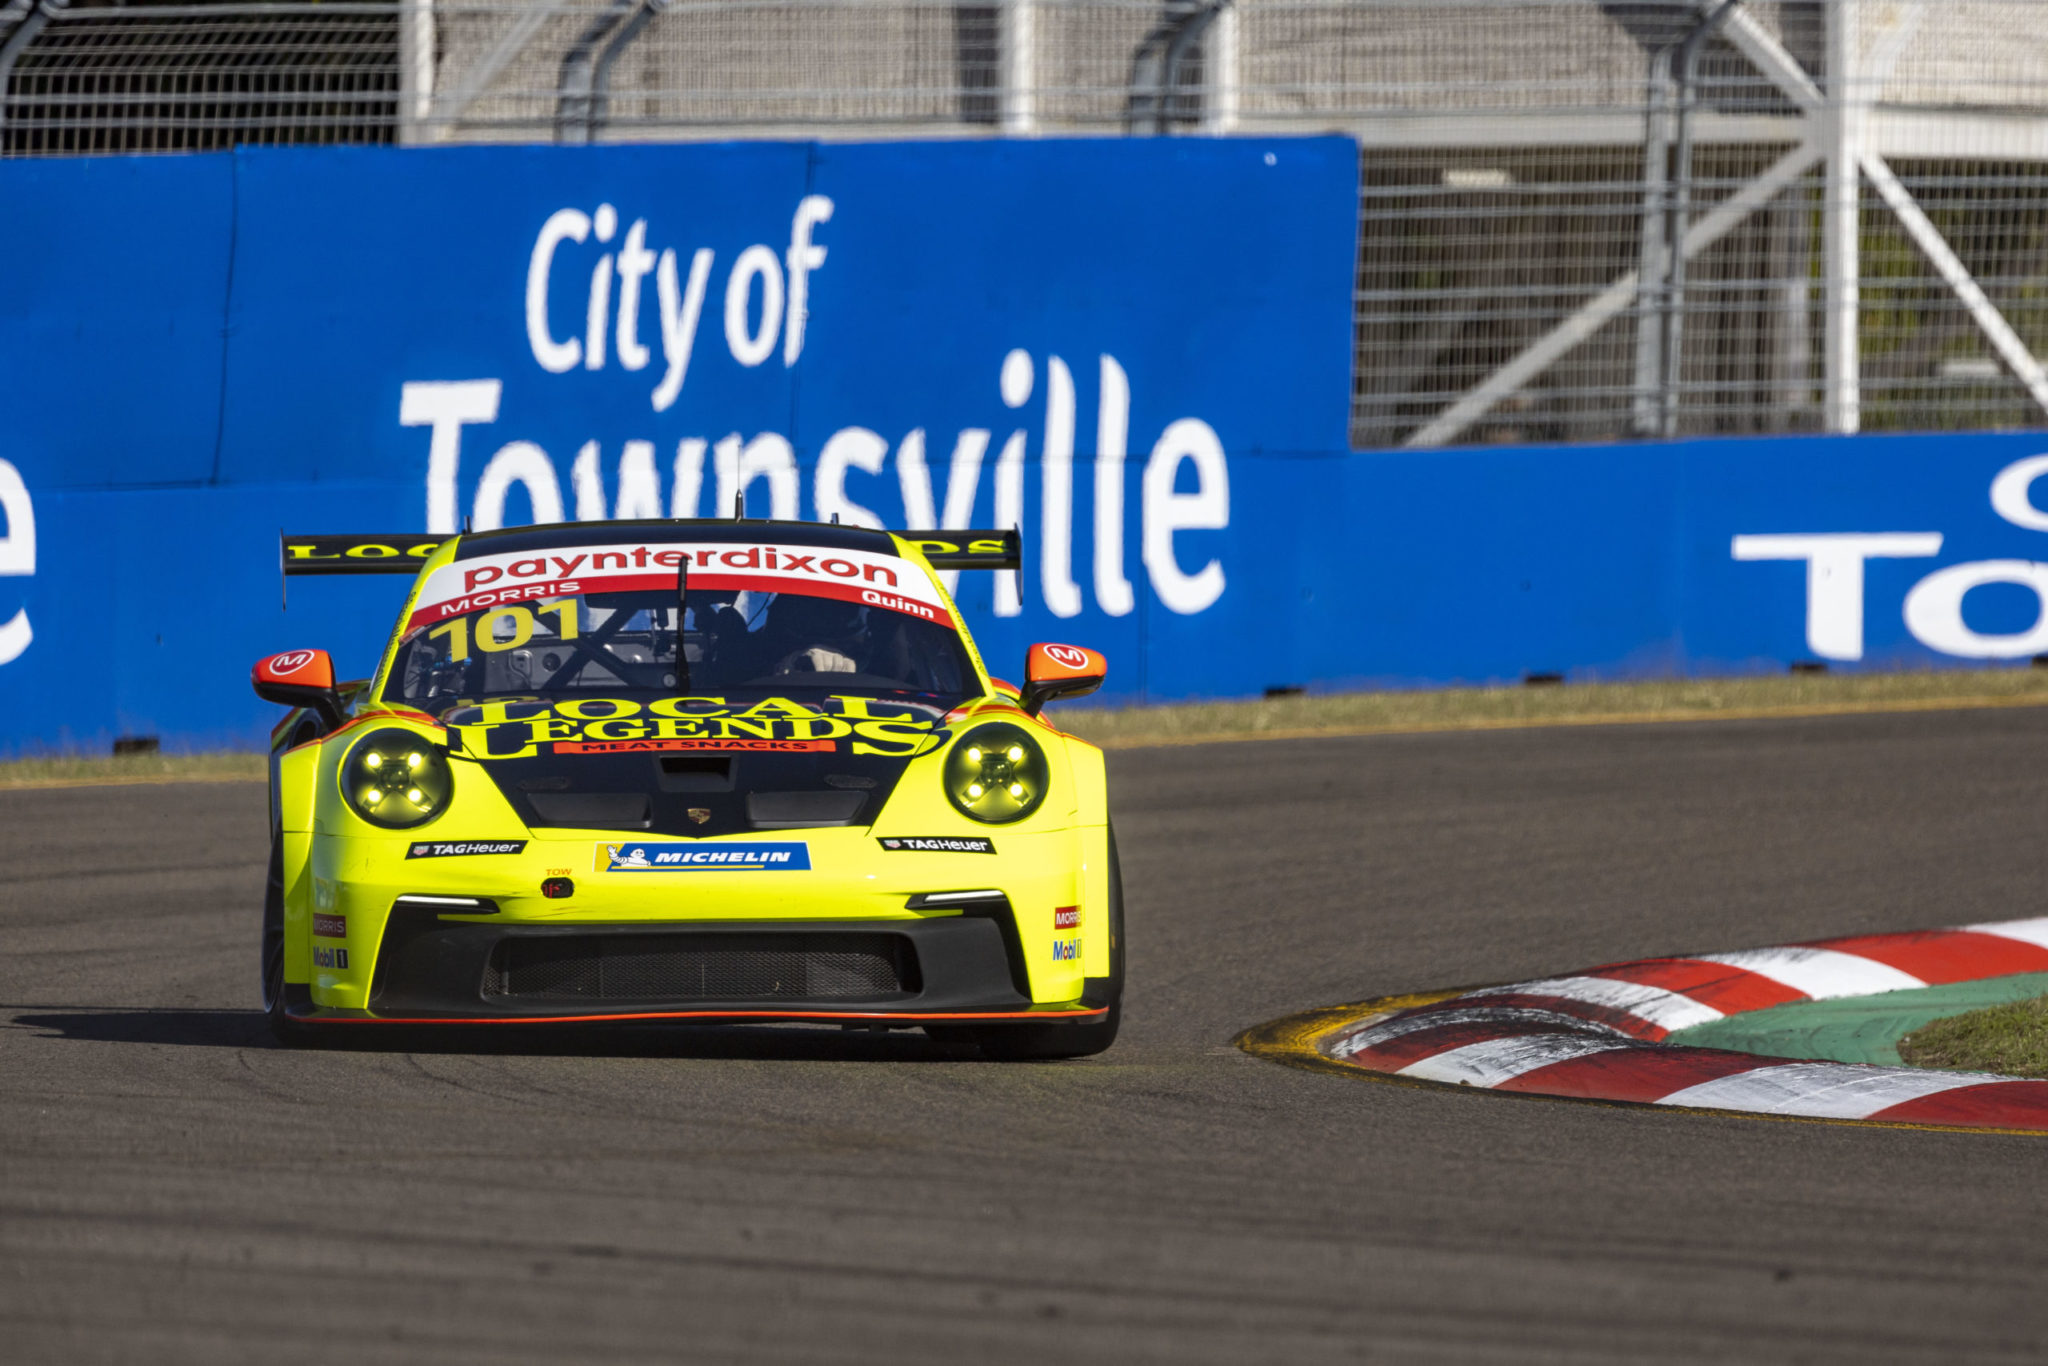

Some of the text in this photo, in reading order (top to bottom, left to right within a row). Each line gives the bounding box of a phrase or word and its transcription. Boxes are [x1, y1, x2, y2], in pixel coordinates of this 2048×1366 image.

[525, 194, 835, 412] City of
[464, 545, 898, 593] paynterdixon
[440, 581, 581, 616] MORRIS
[861, 588, 935, 619] Quinn
[428, 598, 579, 664] 101
[469, 694, 913, 727] LOCAL
[446, 717, 945, 761] LEGENDS
[581, 740, 809, 752] MEAT SNACKS
[545, 868, 573, 877] TOW
[654, 851, 792, 864] MICHELIN
[1052, 938, 1077, 961] Mobil
